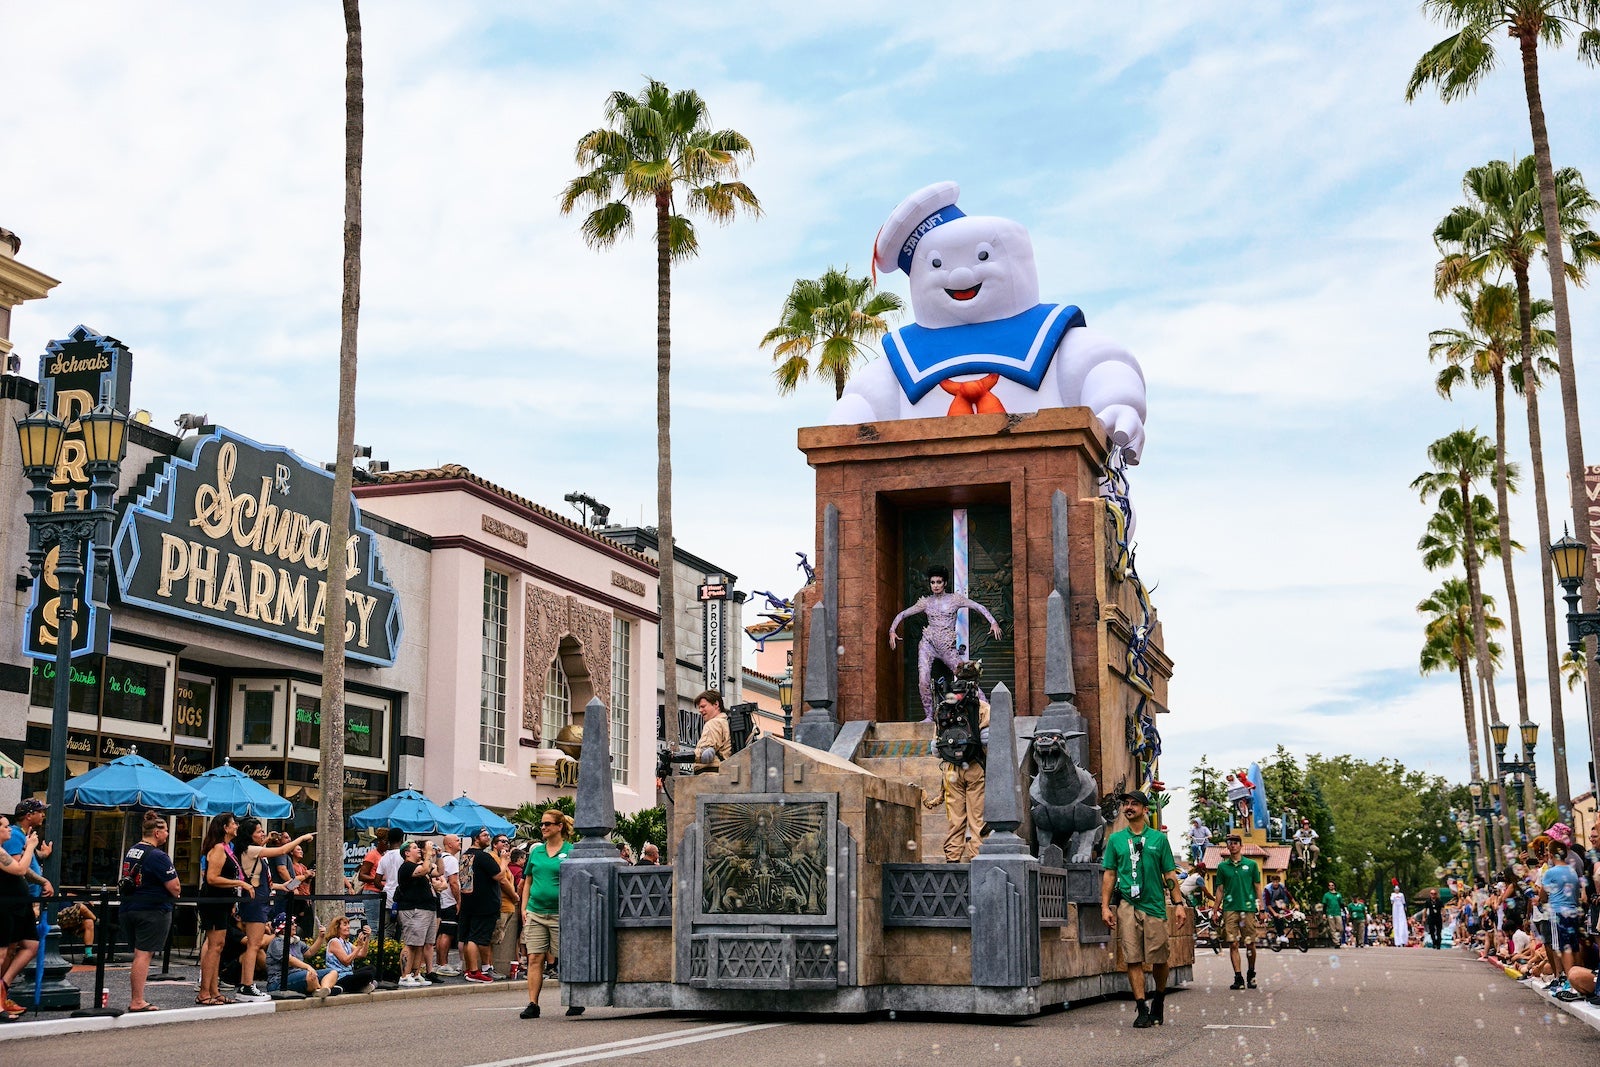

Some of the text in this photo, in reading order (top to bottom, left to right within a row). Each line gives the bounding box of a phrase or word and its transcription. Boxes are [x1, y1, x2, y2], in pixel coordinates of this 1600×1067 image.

[903, 213, 943, 256] STAY PUFT
[50, 352, 110, 374] Schwab's
[69, 666, 96, 685] Drinks
